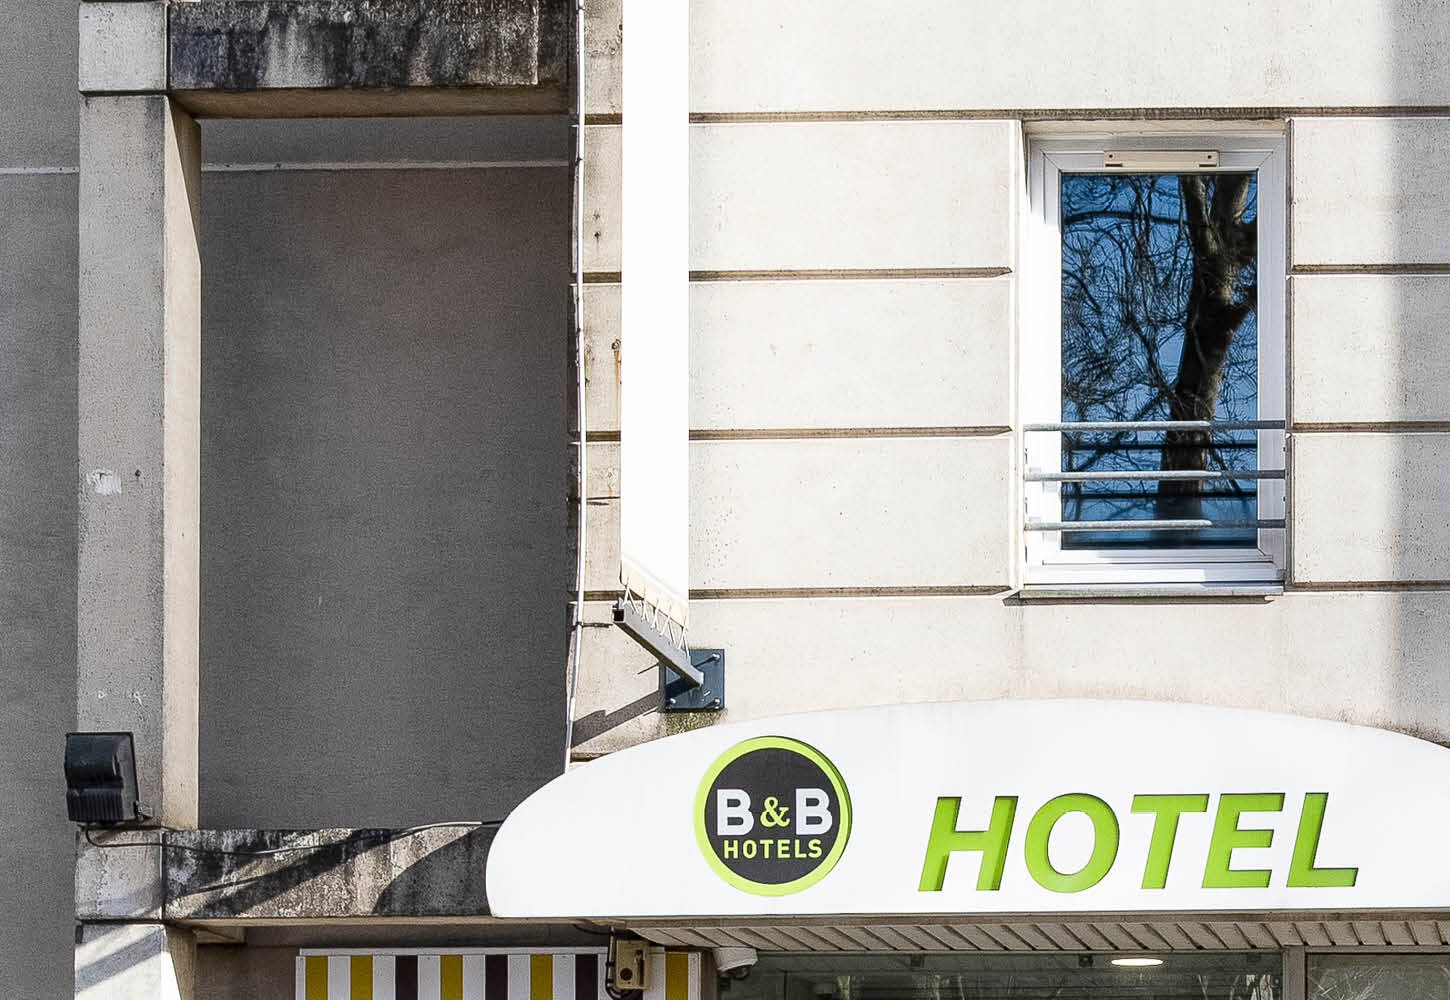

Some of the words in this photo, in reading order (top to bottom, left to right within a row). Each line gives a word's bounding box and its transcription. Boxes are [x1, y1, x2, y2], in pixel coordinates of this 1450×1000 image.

[716, 787, 833, 836] B&B
[723, 838, 823, 859] HOTELS
[918, 792, 1359, 893] HOTEL
